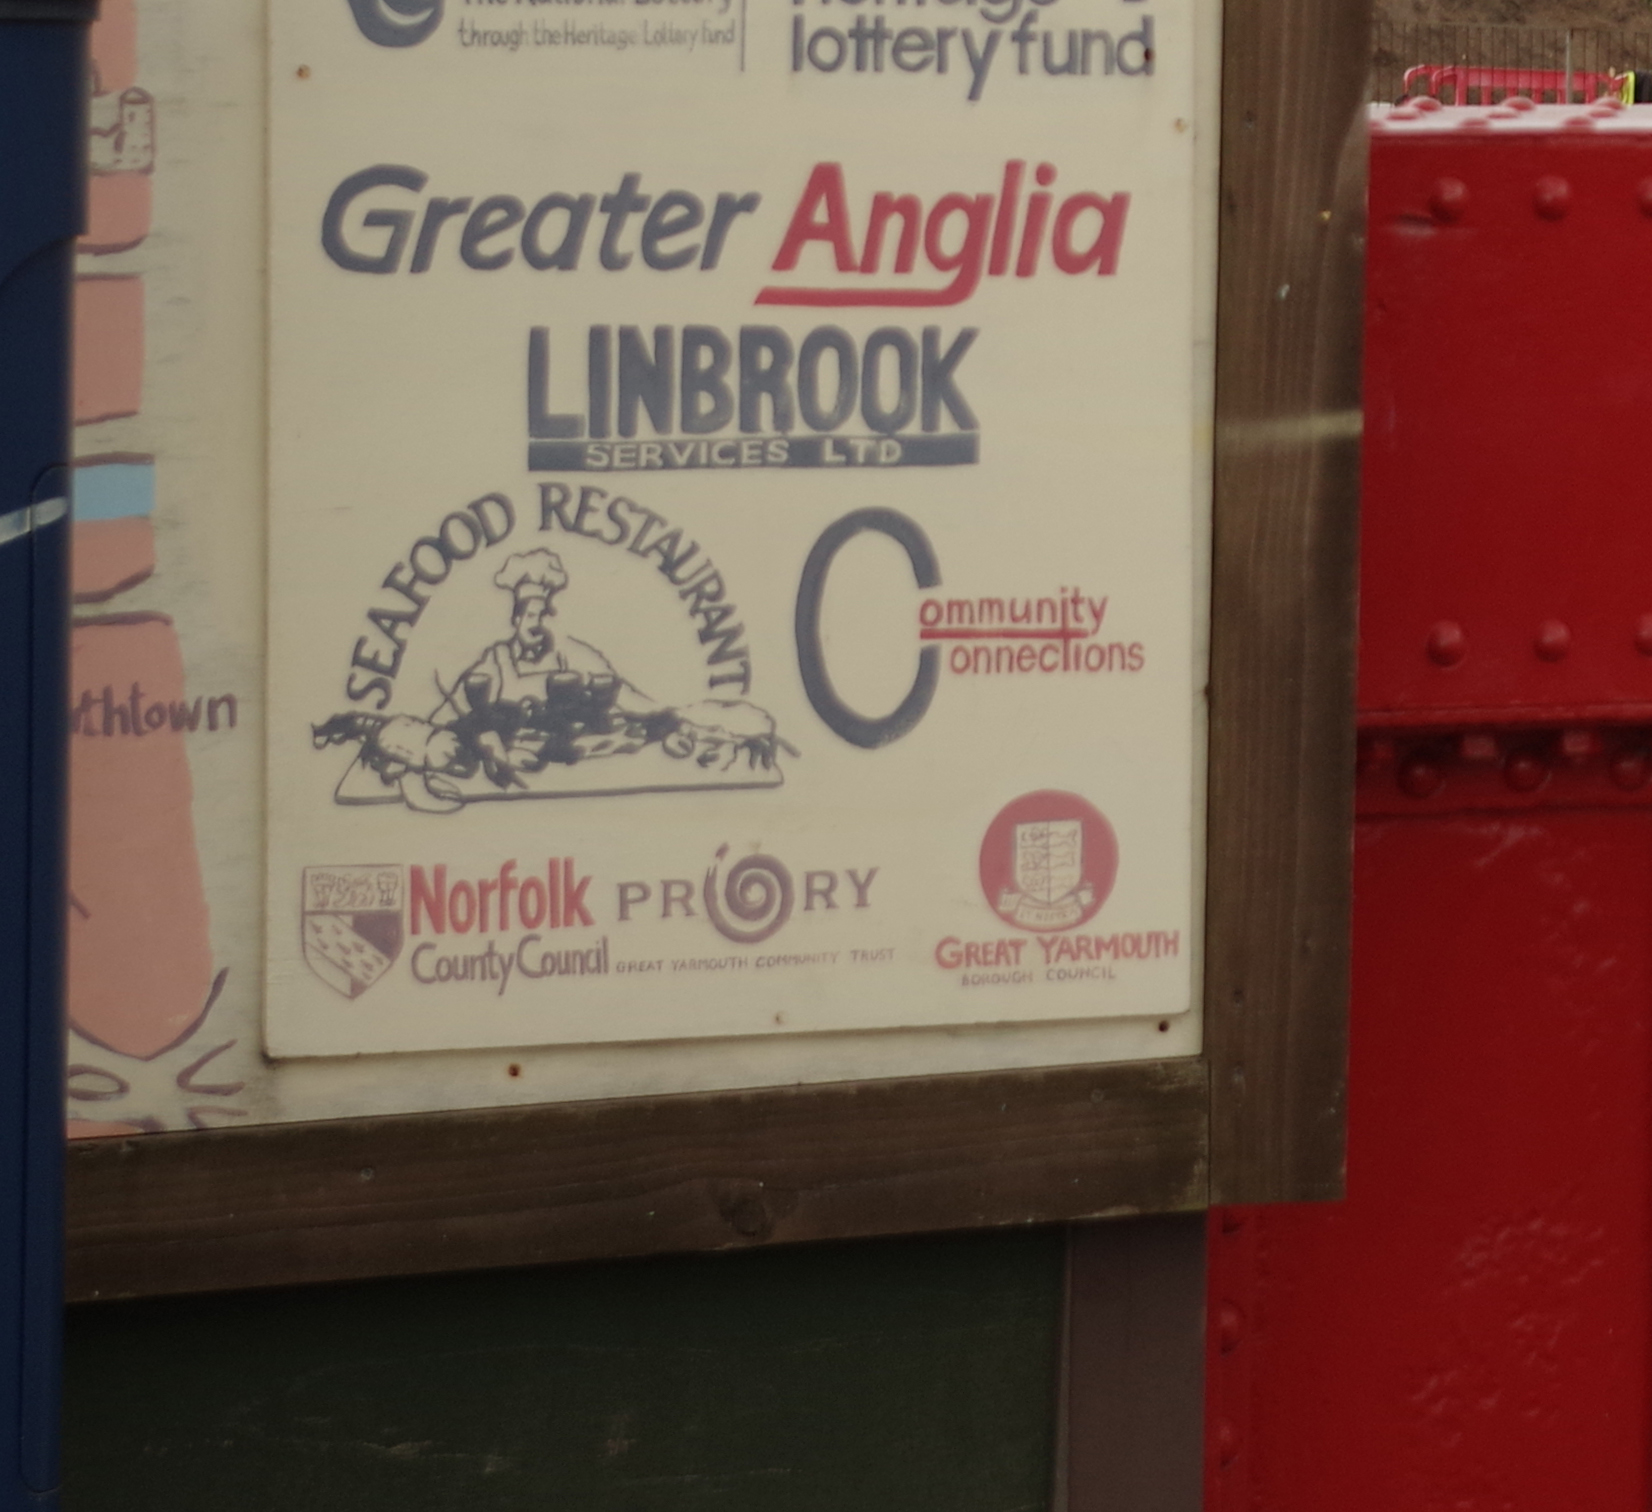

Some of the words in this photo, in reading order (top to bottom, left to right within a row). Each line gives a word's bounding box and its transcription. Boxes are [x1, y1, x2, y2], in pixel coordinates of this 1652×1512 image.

[457, 17, 527, 53] through
[533, 17, 563, 46] the
[563, 19, 638, 51] Heritage
[643, 18, 700, 53] Lottery
[791, 12, 1005, 103] lottery
[1010, 8, 1156, 78] fund
[320, 162, 763, 276] Greater
[756, 159, 1131, 307] Anglia
[528, 323, 981, 440] LINBROOK
[585, 437, 791, 468] SERVICES
[822, 437, 904, 465] LTD
[346, 490, 516, 711] SEAFOOD
[536, 481, 753, 696] RESTAURANT
[409, 856, 597, 936] Norfolk
[410, 938, 517, 998] County
[516, 933, 610, 979] Council
[616, 959, 665, 974] GREAT
[671, 955, 748, 972] YARMOUTH
[755, 950, 840, 969] COMMUNITY
[850, 947, 897, 963] TRUST
[934, 935, 1028, 970] GREAT
[1036, 930, 1180, 965] YARMOUTH
[961, 970, 1034, 987] BOROUGH
[1046, 965, 1117, 982] COUNCIL
